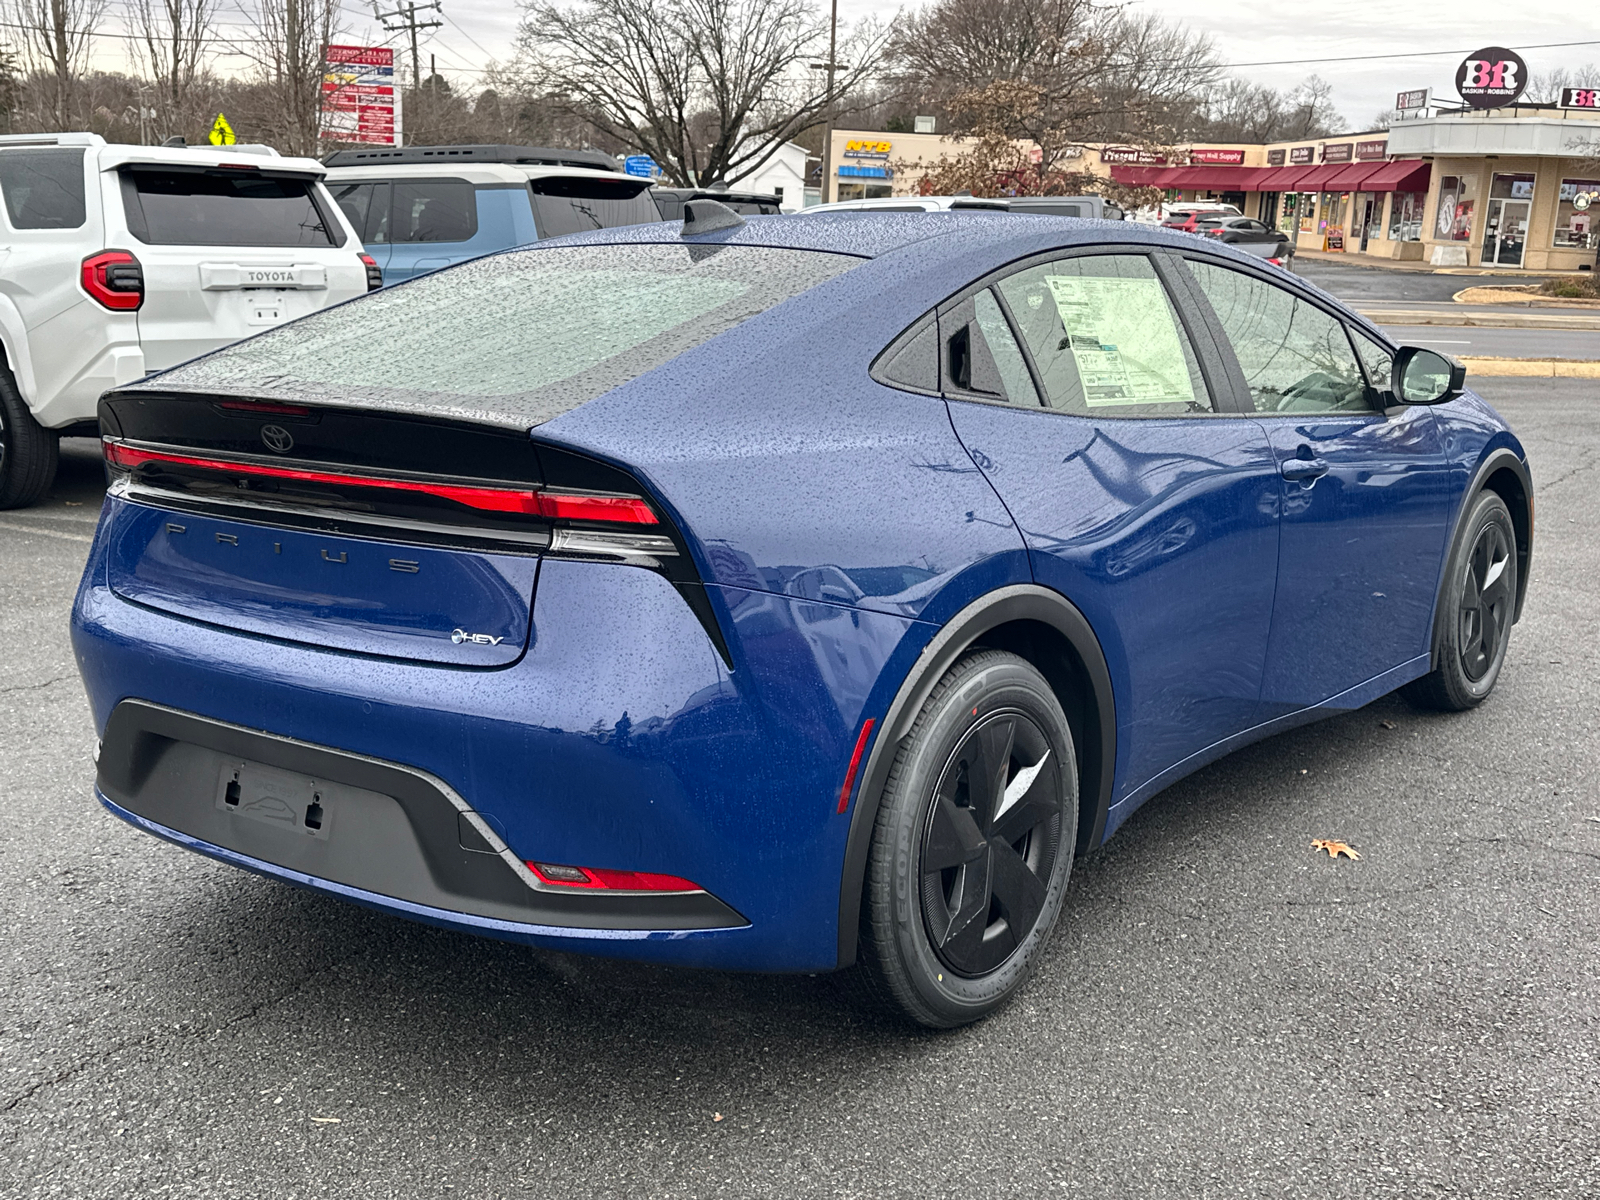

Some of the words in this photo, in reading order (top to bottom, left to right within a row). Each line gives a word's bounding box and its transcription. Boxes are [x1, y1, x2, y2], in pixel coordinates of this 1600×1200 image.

[845, 140, 892, 153] NTB
[1219, 152, 1241, 161] Supply
[248, 272, 295, 281] TOYOTA
[165, 522, 420, 574] PRIUS
[463, 632, 504, 646] HEV
